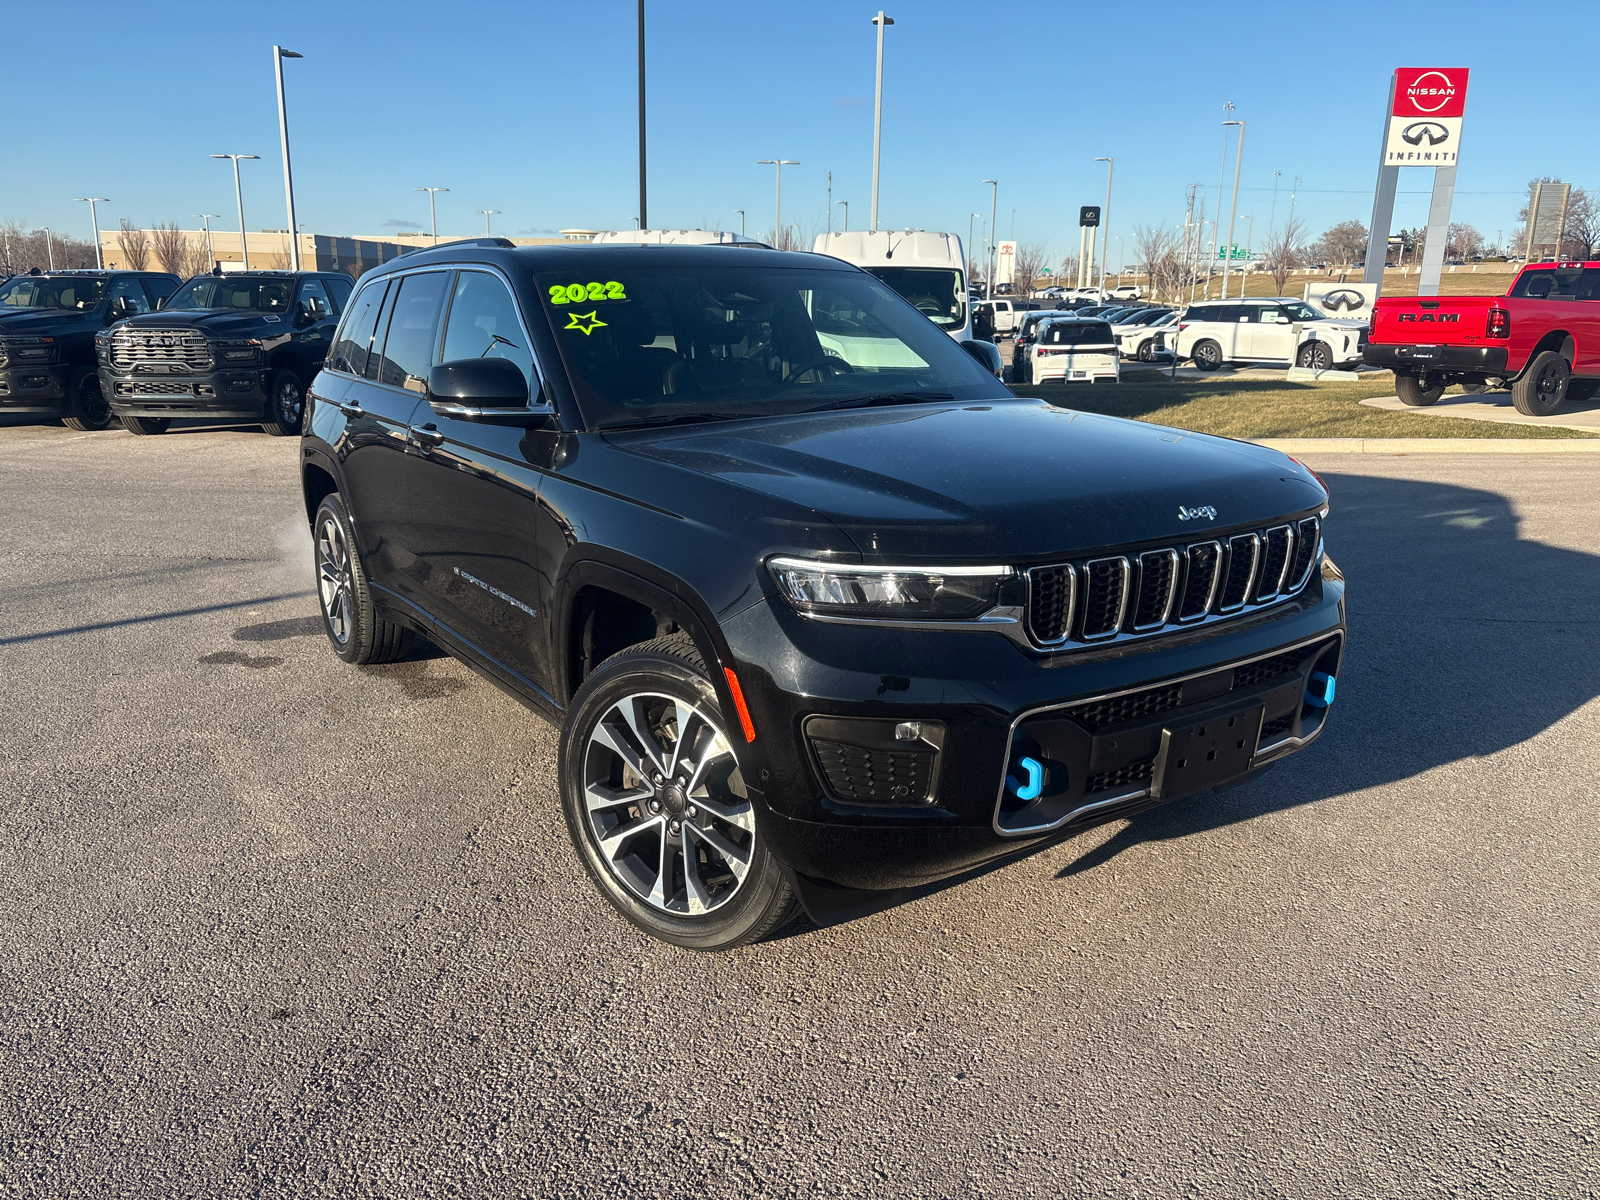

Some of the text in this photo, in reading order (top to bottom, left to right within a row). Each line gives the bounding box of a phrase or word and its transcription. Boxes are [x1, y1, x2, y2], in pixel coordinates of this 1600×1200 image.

[1389, 152, 1456, 161] INFINITI
[548, 281, 627, 305] 2022
[1398, 313, 1460, 323] RAM
[131, 336, 181, 346] RAM
[1178, 505, 1218, 521] Jeep
